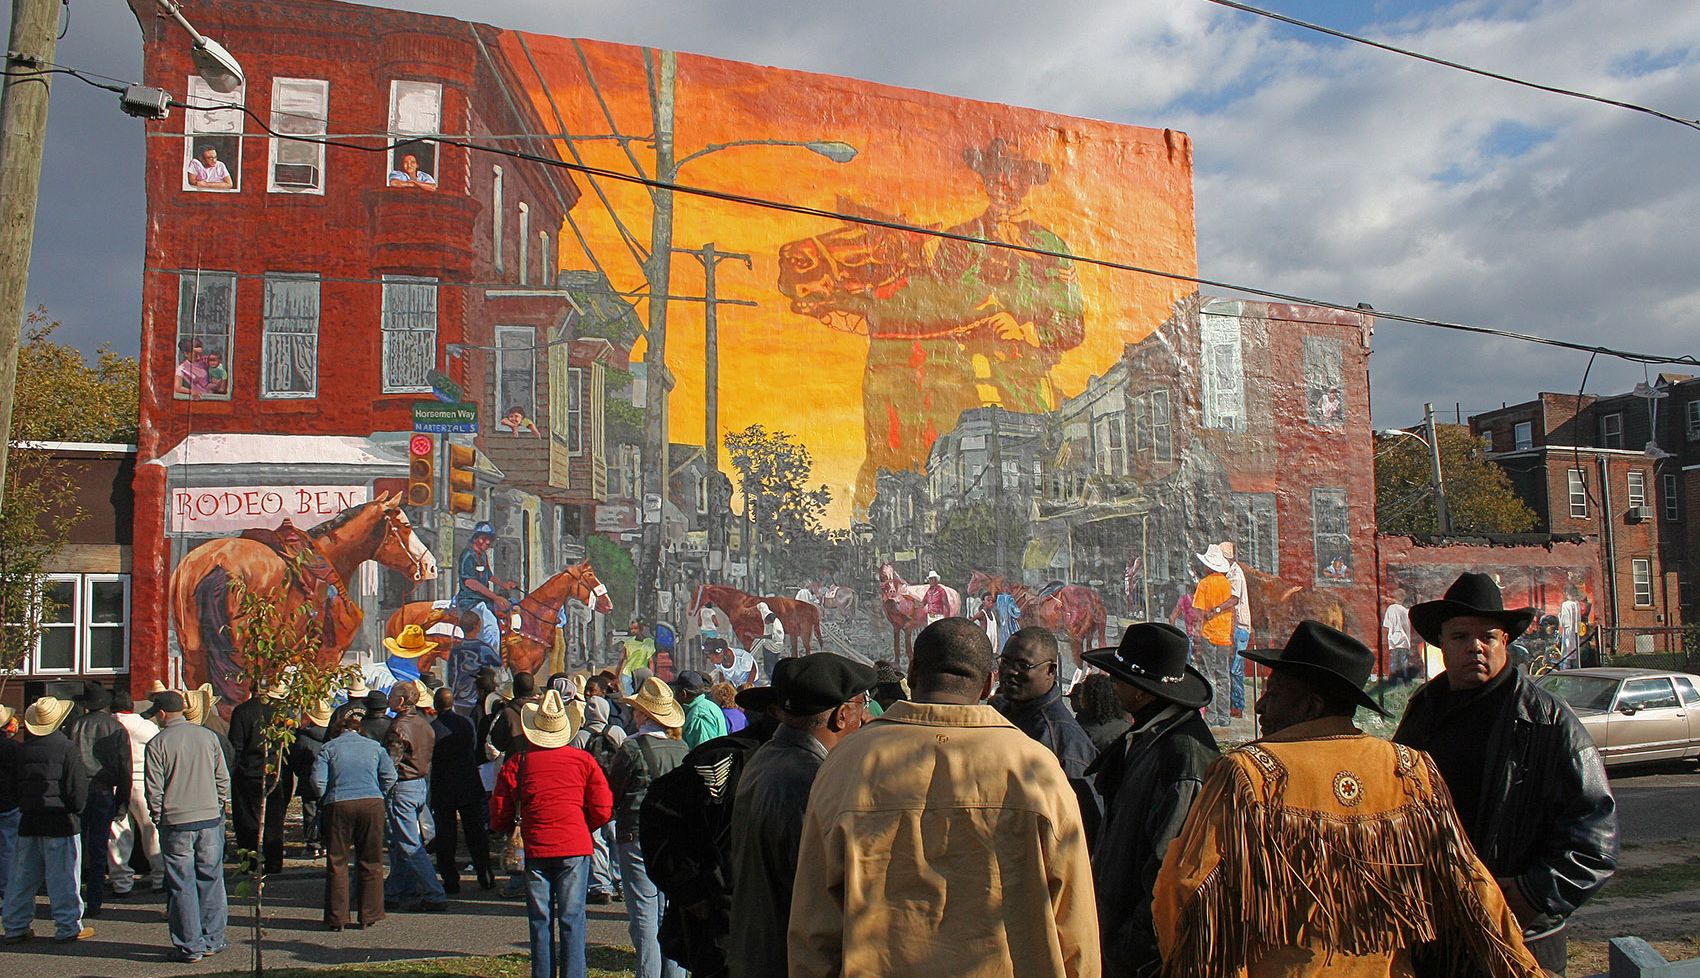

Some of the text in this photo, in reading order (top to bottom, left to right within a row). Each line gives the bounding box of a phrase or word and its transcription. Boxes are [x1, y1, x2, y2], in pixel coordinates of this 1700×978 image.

[415, 409, 475, 420] Horsemen Way
[176, 488, 358, 521] RODEO BEN
